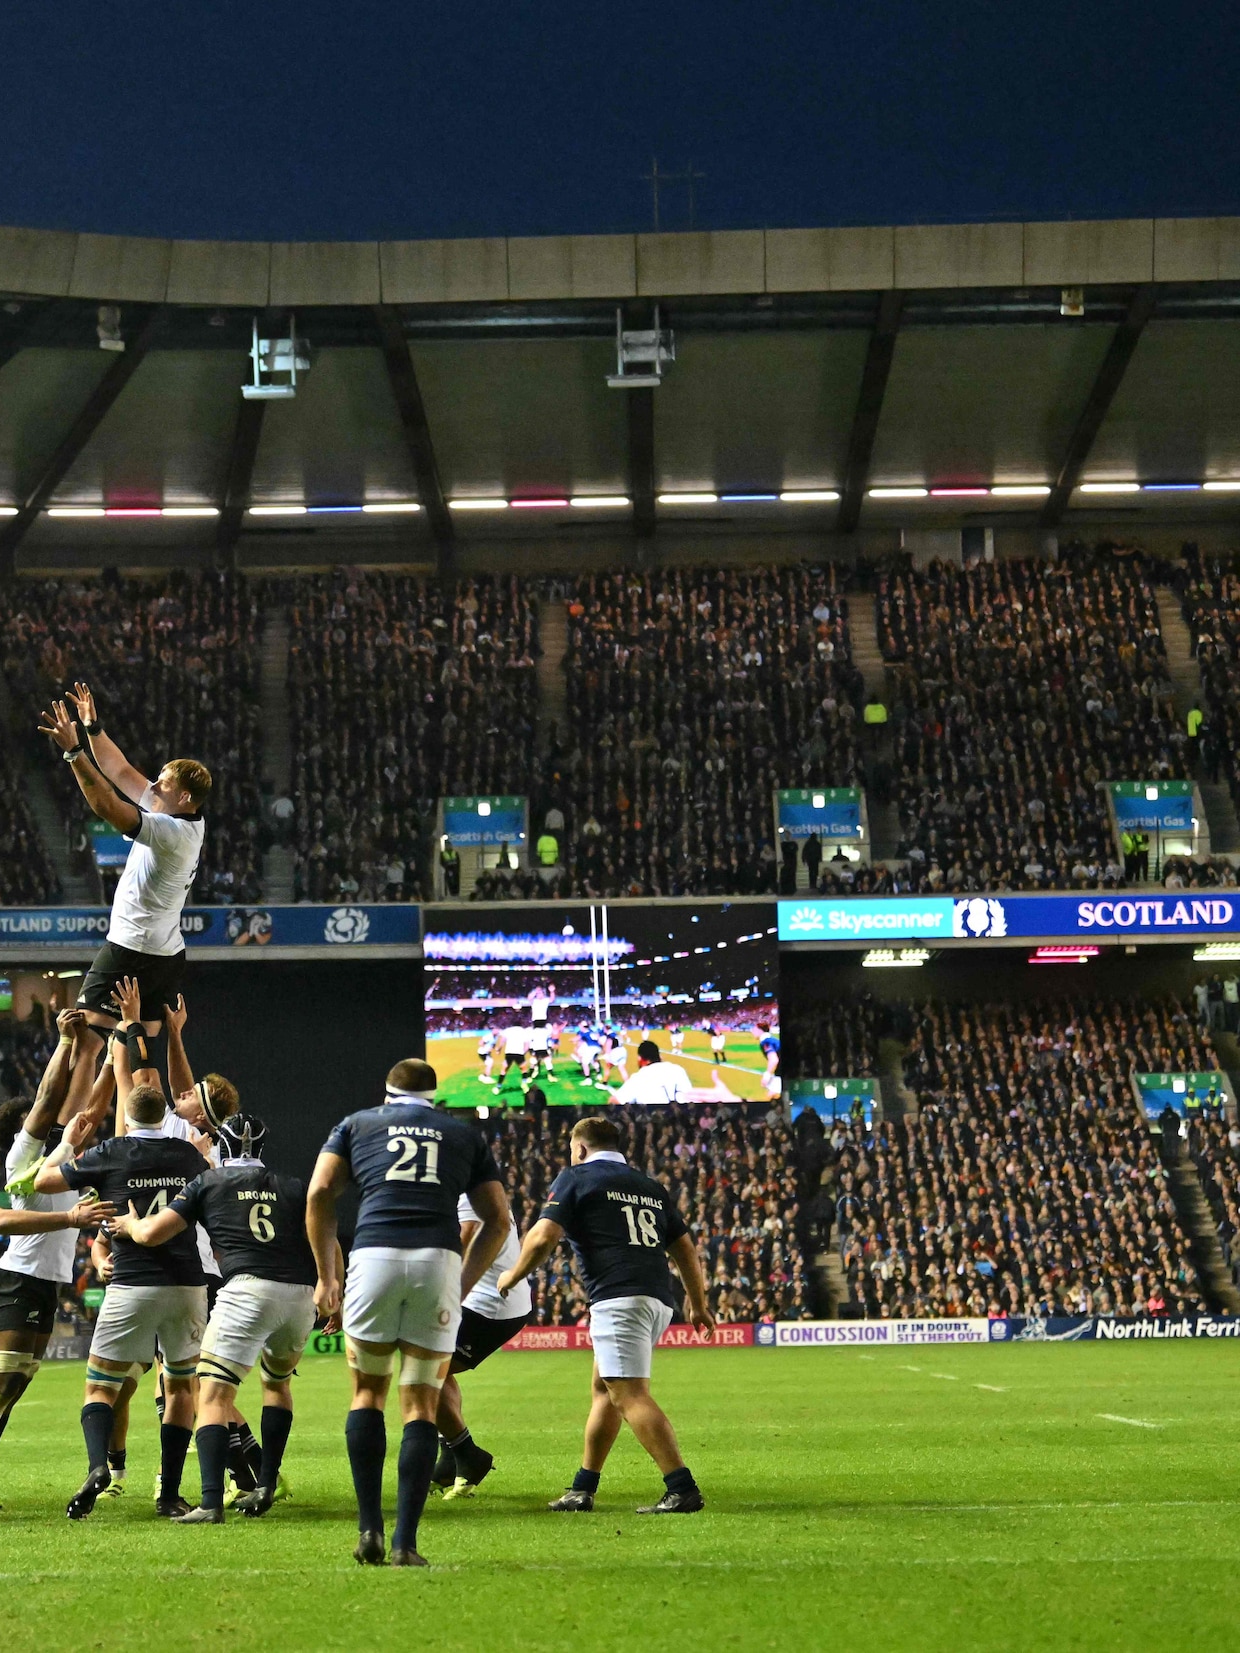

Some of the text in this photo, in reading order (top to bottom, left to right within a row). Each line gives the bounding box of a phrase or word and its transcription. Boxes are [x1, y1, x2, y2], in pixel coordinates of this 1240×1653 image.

[830, 823, 852, 834] Gas
[1163, 815, 1185, 826] Gas
[495, 831, 517, 841] Gas
[828, 910, 944, 935] Skyscanner
[1077, 900, 1234, 928] SCOTLAND
[56, 917, 109, 933] SUPPO
[387, 1125, 443, 1142] BAYLISS
[385, 1136, 441, 1185] 21
[126, 1176, 187, 1189] CUMMINGS
[144, 1189, 168, 1218] 4
[237, 1190, 278, 1202] BROWN
[606, 1190, 663, 1211] MILLAR MILLS
[248, 1203, 276, 1243] 6
[620, 1205, 661, 1248] 18
[780, 1326, 888, 1343] CONCUSSION
[896, 1324, 909, 1332] IF
[911, 1323, 924, 1332] IN
[1095, 1317, 1240, 1339] NorthLink Ferri
[575, 1328, 745, 1347] FU ARACTER
[897, 1333, 916, 1343] SIT
[920, 1332, 955, 1342] THEM
